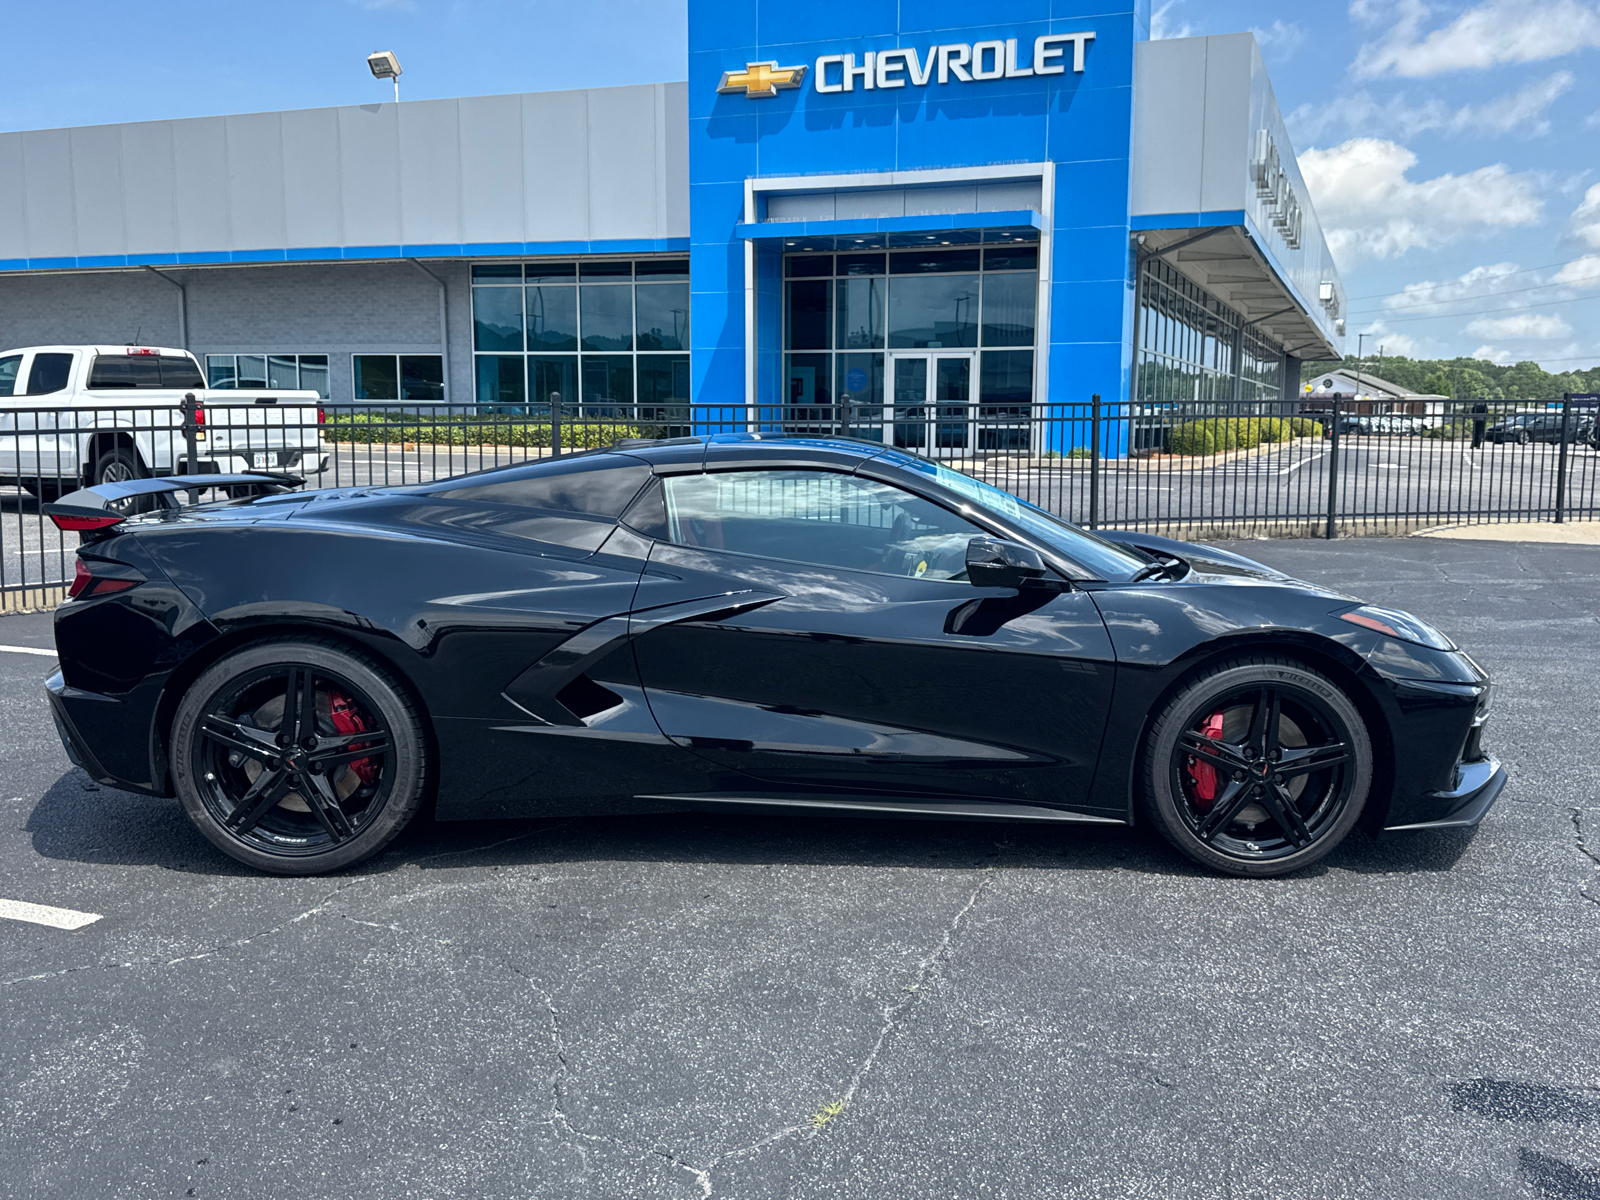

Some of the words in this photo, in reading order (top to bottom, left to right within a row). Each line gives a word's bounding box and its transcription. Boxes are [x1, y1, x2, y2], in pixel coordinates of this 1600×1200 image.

[815, 32, 1096, 93] CHEVROLET
[1283, 671, 1330, 697] MICHELIN
[177, 714, 191, 774] MICHELIN
